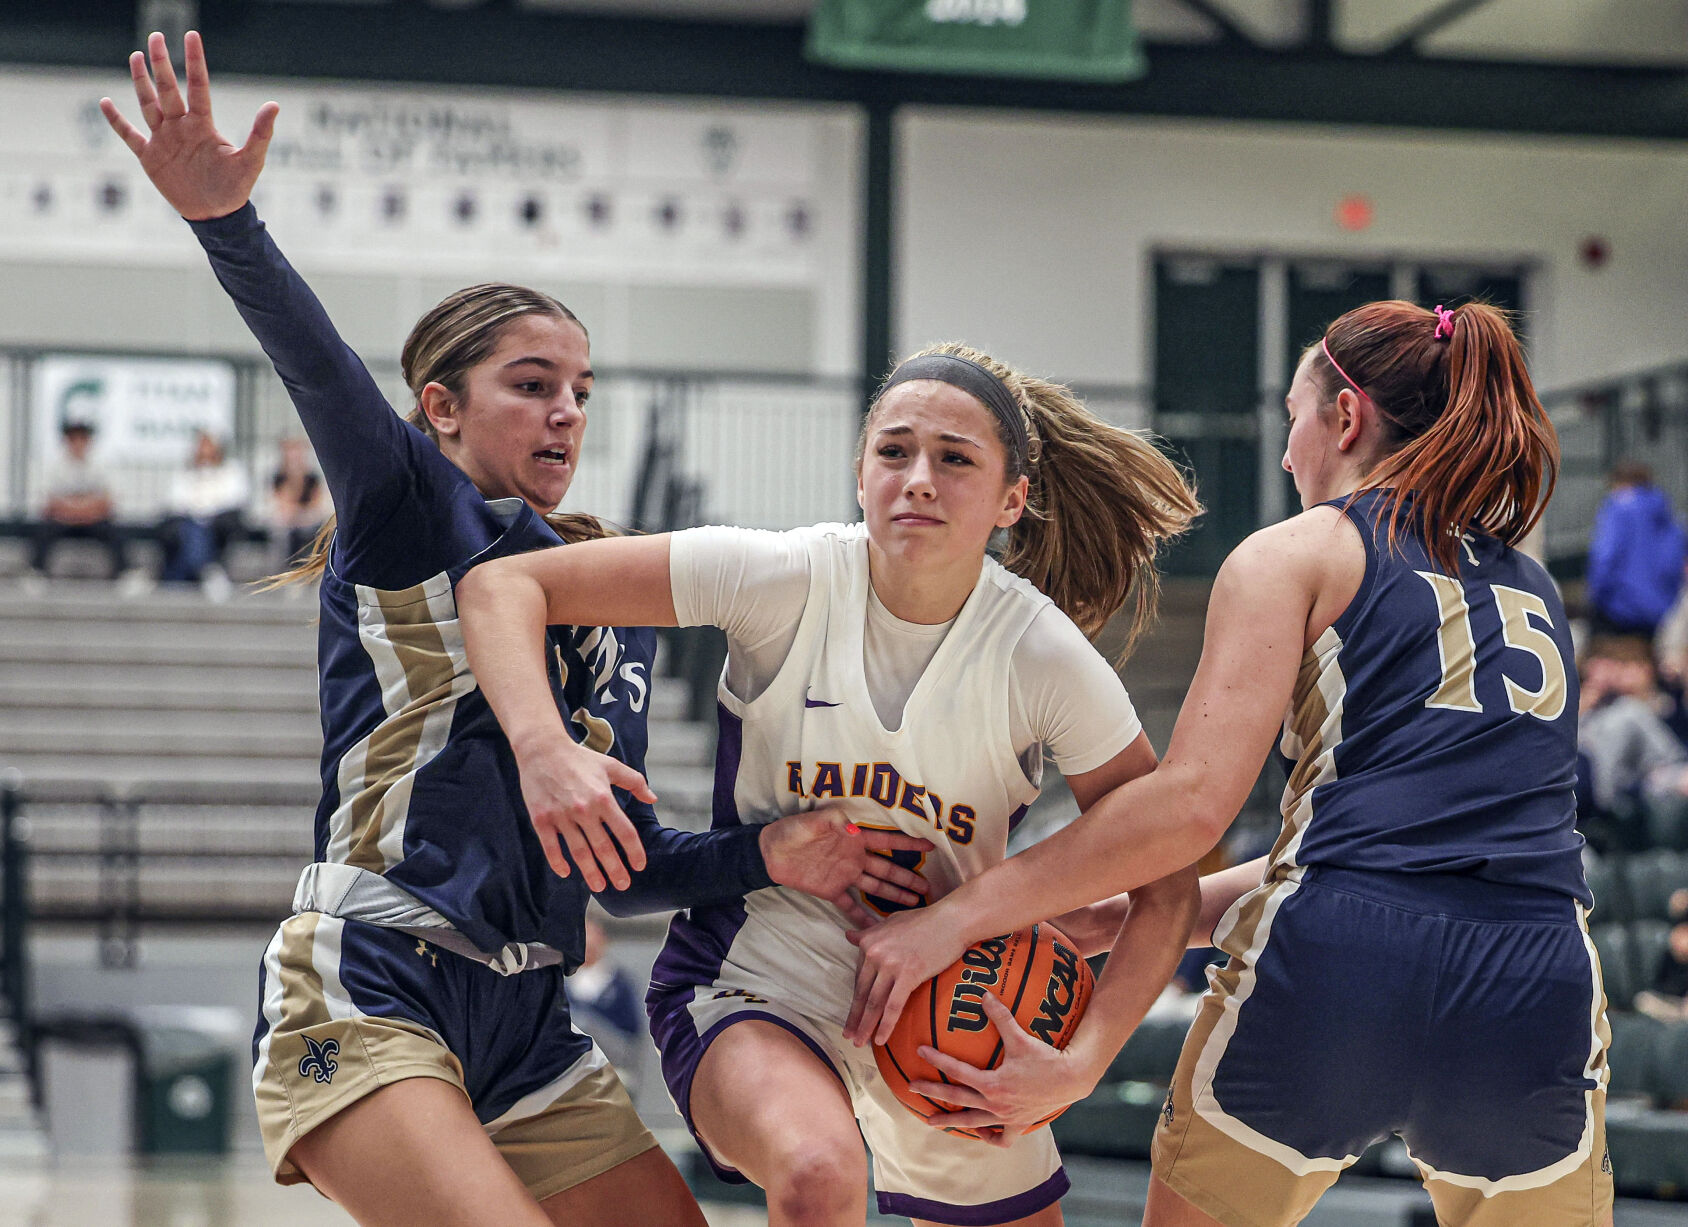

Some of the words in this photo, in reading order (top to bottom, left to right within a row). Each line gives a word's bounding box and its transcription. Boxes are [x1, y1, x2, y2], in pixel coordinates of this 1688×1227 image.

[1413, 569, 1568, 721] 15
[947, 932, 1013, 1033] Wils
[1029, 939, 1079, 1048] NCAA
